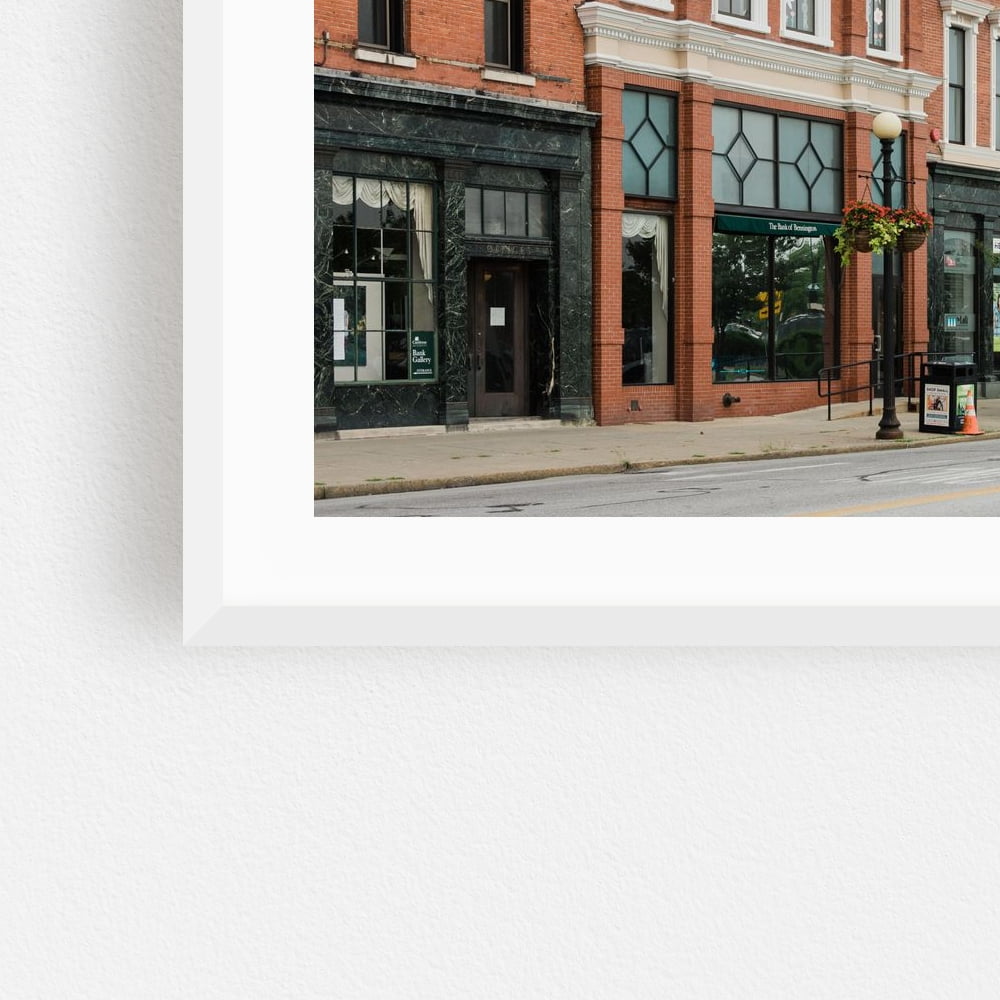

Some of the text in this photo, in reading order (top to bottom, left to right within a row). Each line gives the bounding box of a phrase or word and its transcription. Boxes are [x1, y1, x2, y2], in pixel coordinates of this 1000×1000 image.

[769, 222, 777, 230] The
[778, 222, 787, 230] Bank
[413, 356, 431, 364] Gallery
